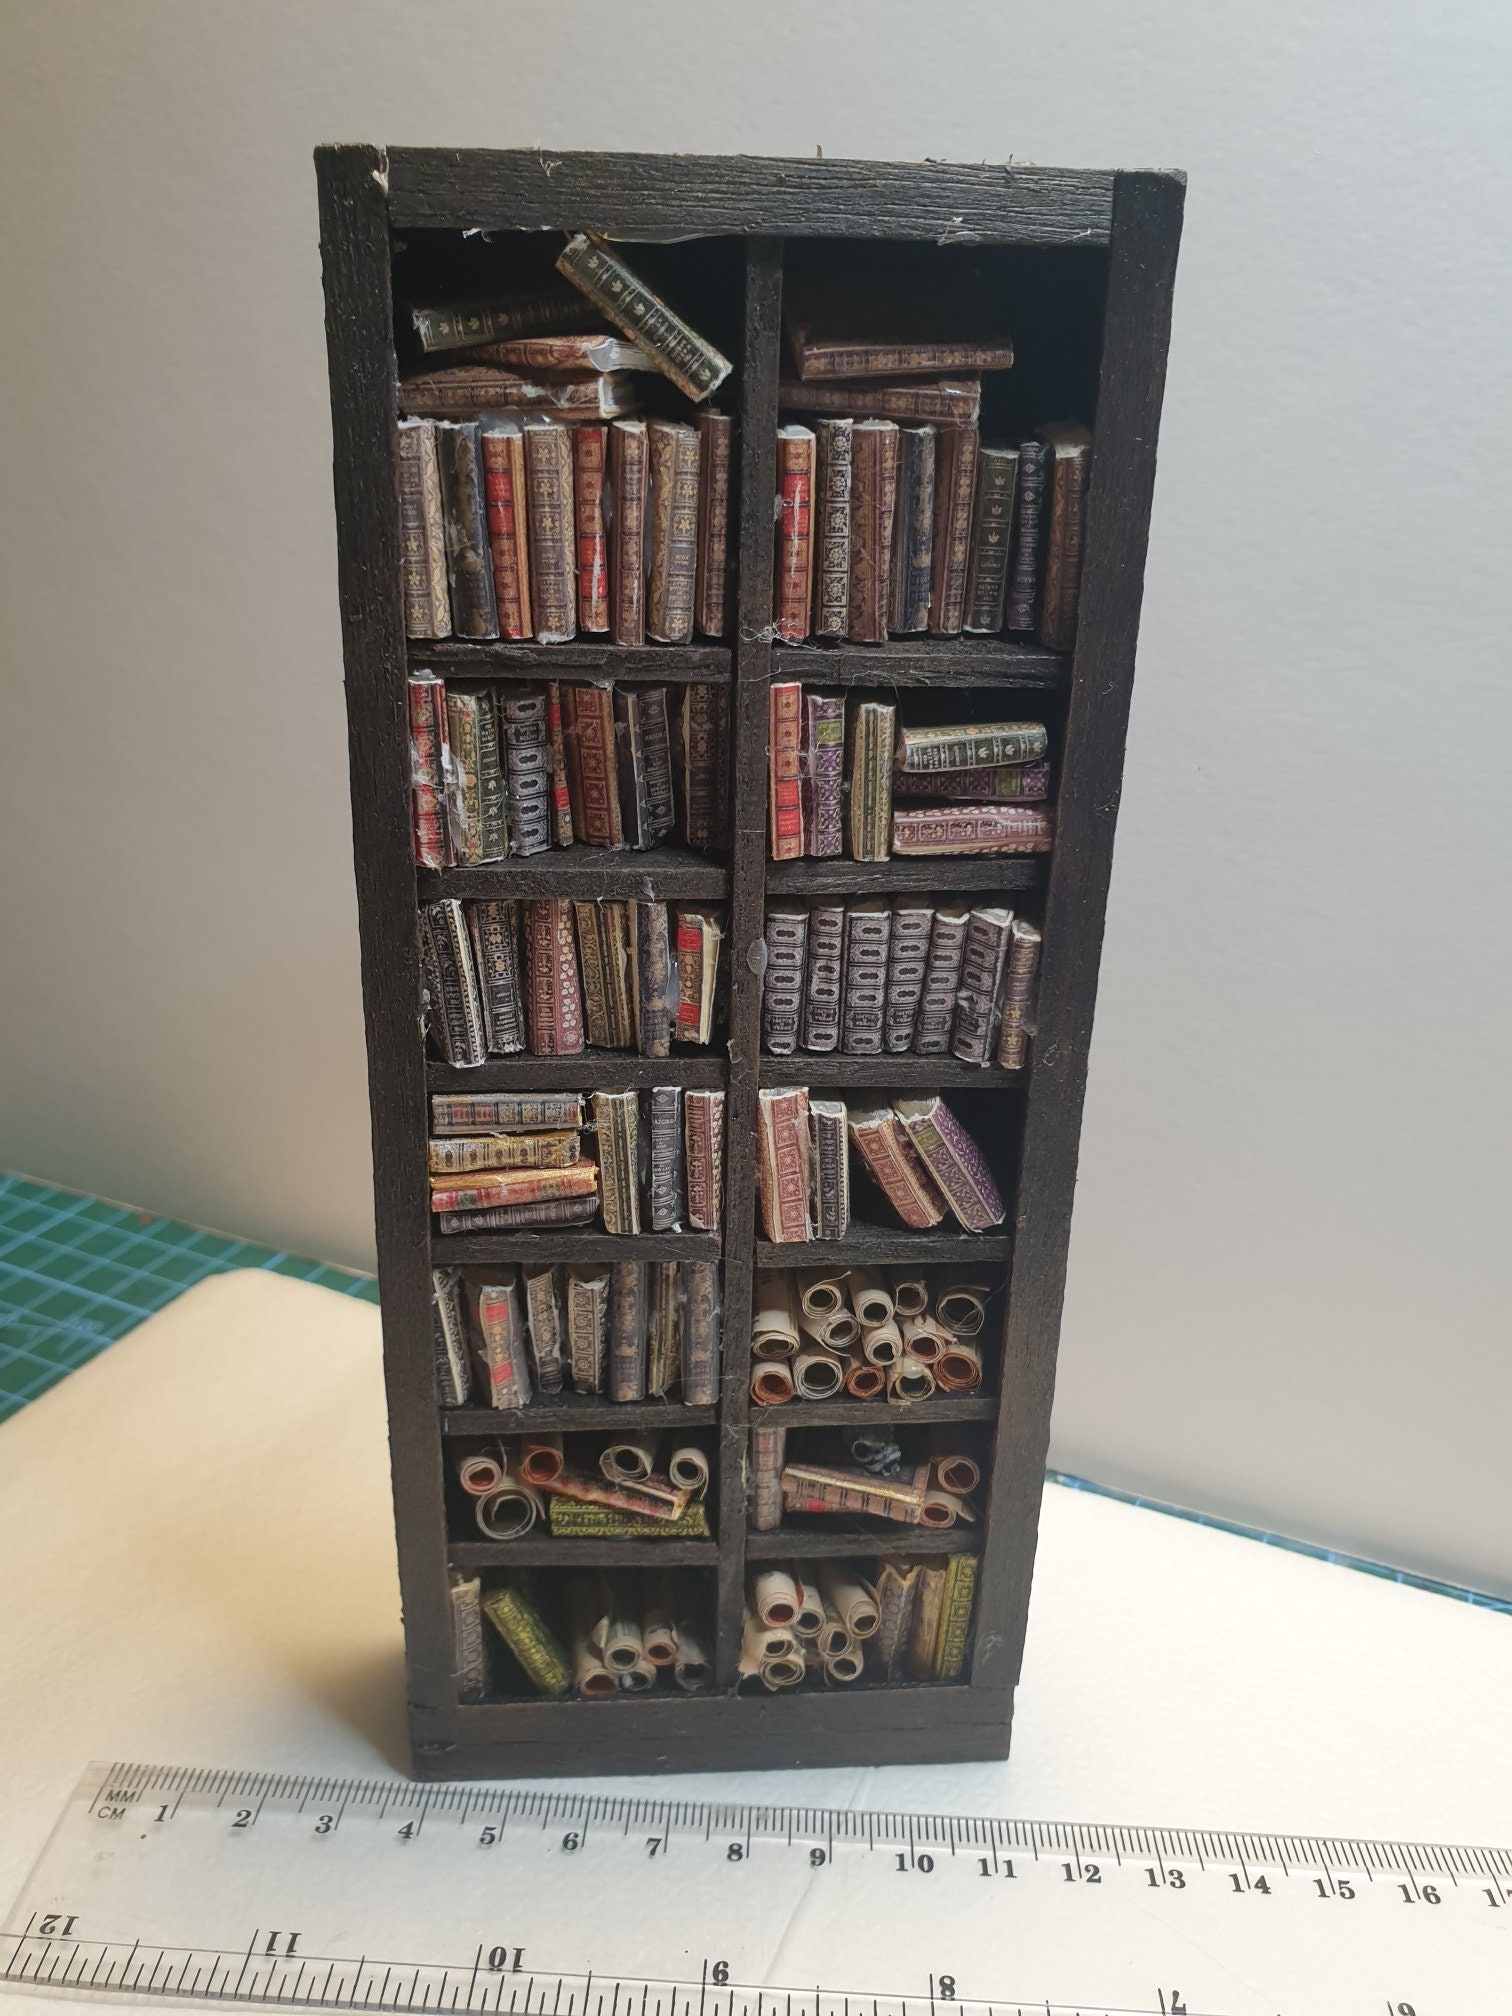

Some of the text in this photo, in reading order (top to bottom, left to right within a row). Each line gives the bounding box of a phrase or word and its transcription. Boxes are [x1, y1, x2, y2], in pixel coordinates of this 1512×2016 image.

[104, 1789, 137, 1803] MM
[97, 1806, 127, 1820] CM
[153, 1804, 169, 1823] 1
[231, 1809, 252, 1828] 2
[314, 1814, 334, 1834] 3
[397, 1821, 414, 1840] 4
[479, 1826, 497, 1846] 5
[561, 1832, 579, 1851] 6
[645, 1837, 663, 1857] 7
[727, 1842, 744, 1862] 8
[809, 1847, 827, 1867] 9
[894, 1852, 935, 1874] 10
[977, 1857, 1018, 1879] 11
[1060, 1862, 1102, 1884] 12
[1144, 1867, 1187, 1890] 13
[1228, 1872, 1273, 1895] 14
[1312, 1878, 1356, 1900] 15
[1396, 1883, 1442, 1905] 16
[38, 1913, 80, 1937] 12
[265, 1930, 303, 1954] 11
[488, 1946, 526, 1972] 10
[938, 1975, 956, 1998] 8
